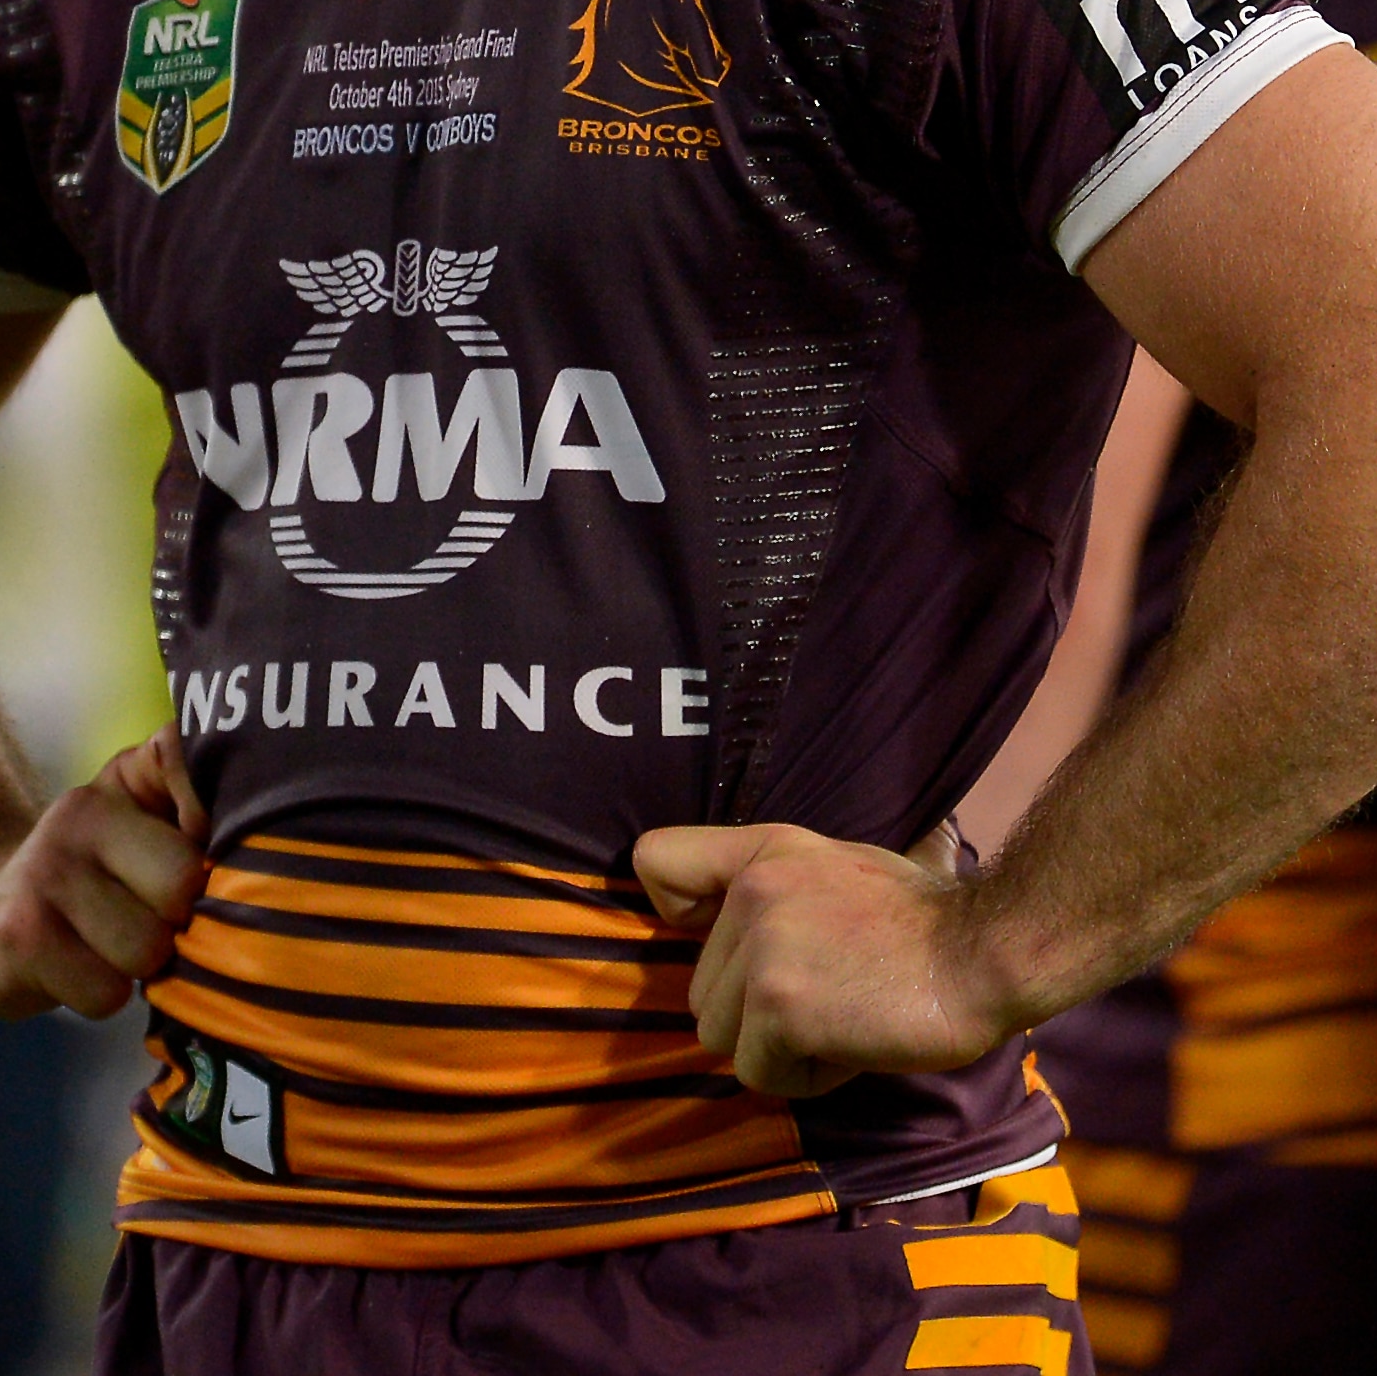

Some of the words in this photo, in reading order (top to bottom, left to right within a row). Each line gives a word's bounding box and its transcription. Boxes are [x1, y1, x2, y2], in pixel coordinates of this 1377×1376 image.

[143, 10, 220, 55] NRL
[303, 44, 328, 73] NRL
[333, 41, 376, 71] Telstra
[379, 37, 452, 70] Premiership
[454, 28, 485, 63] Grand
[484, 27, 518, 57] Final
[135, 66, 217, 90] PREMIERSHIP
[153, 51, 203, 73] TELSTRA
[329, 80, 384, 111] October
[387, 78, 412, 107] 4th
[415, 76, 443, 106] 2015
[445, 71, 480, 109] Sydney
[293, 123, 394, 159] BRONCOS
[406, 123, 420, 154] V
[426, 113, 497, 153] COWBOYS
[557, 118, 721, 147] BRONCOS
[569, 141, 710, 161] BRISBANE
[175, 367, 666, 511] NRMA
